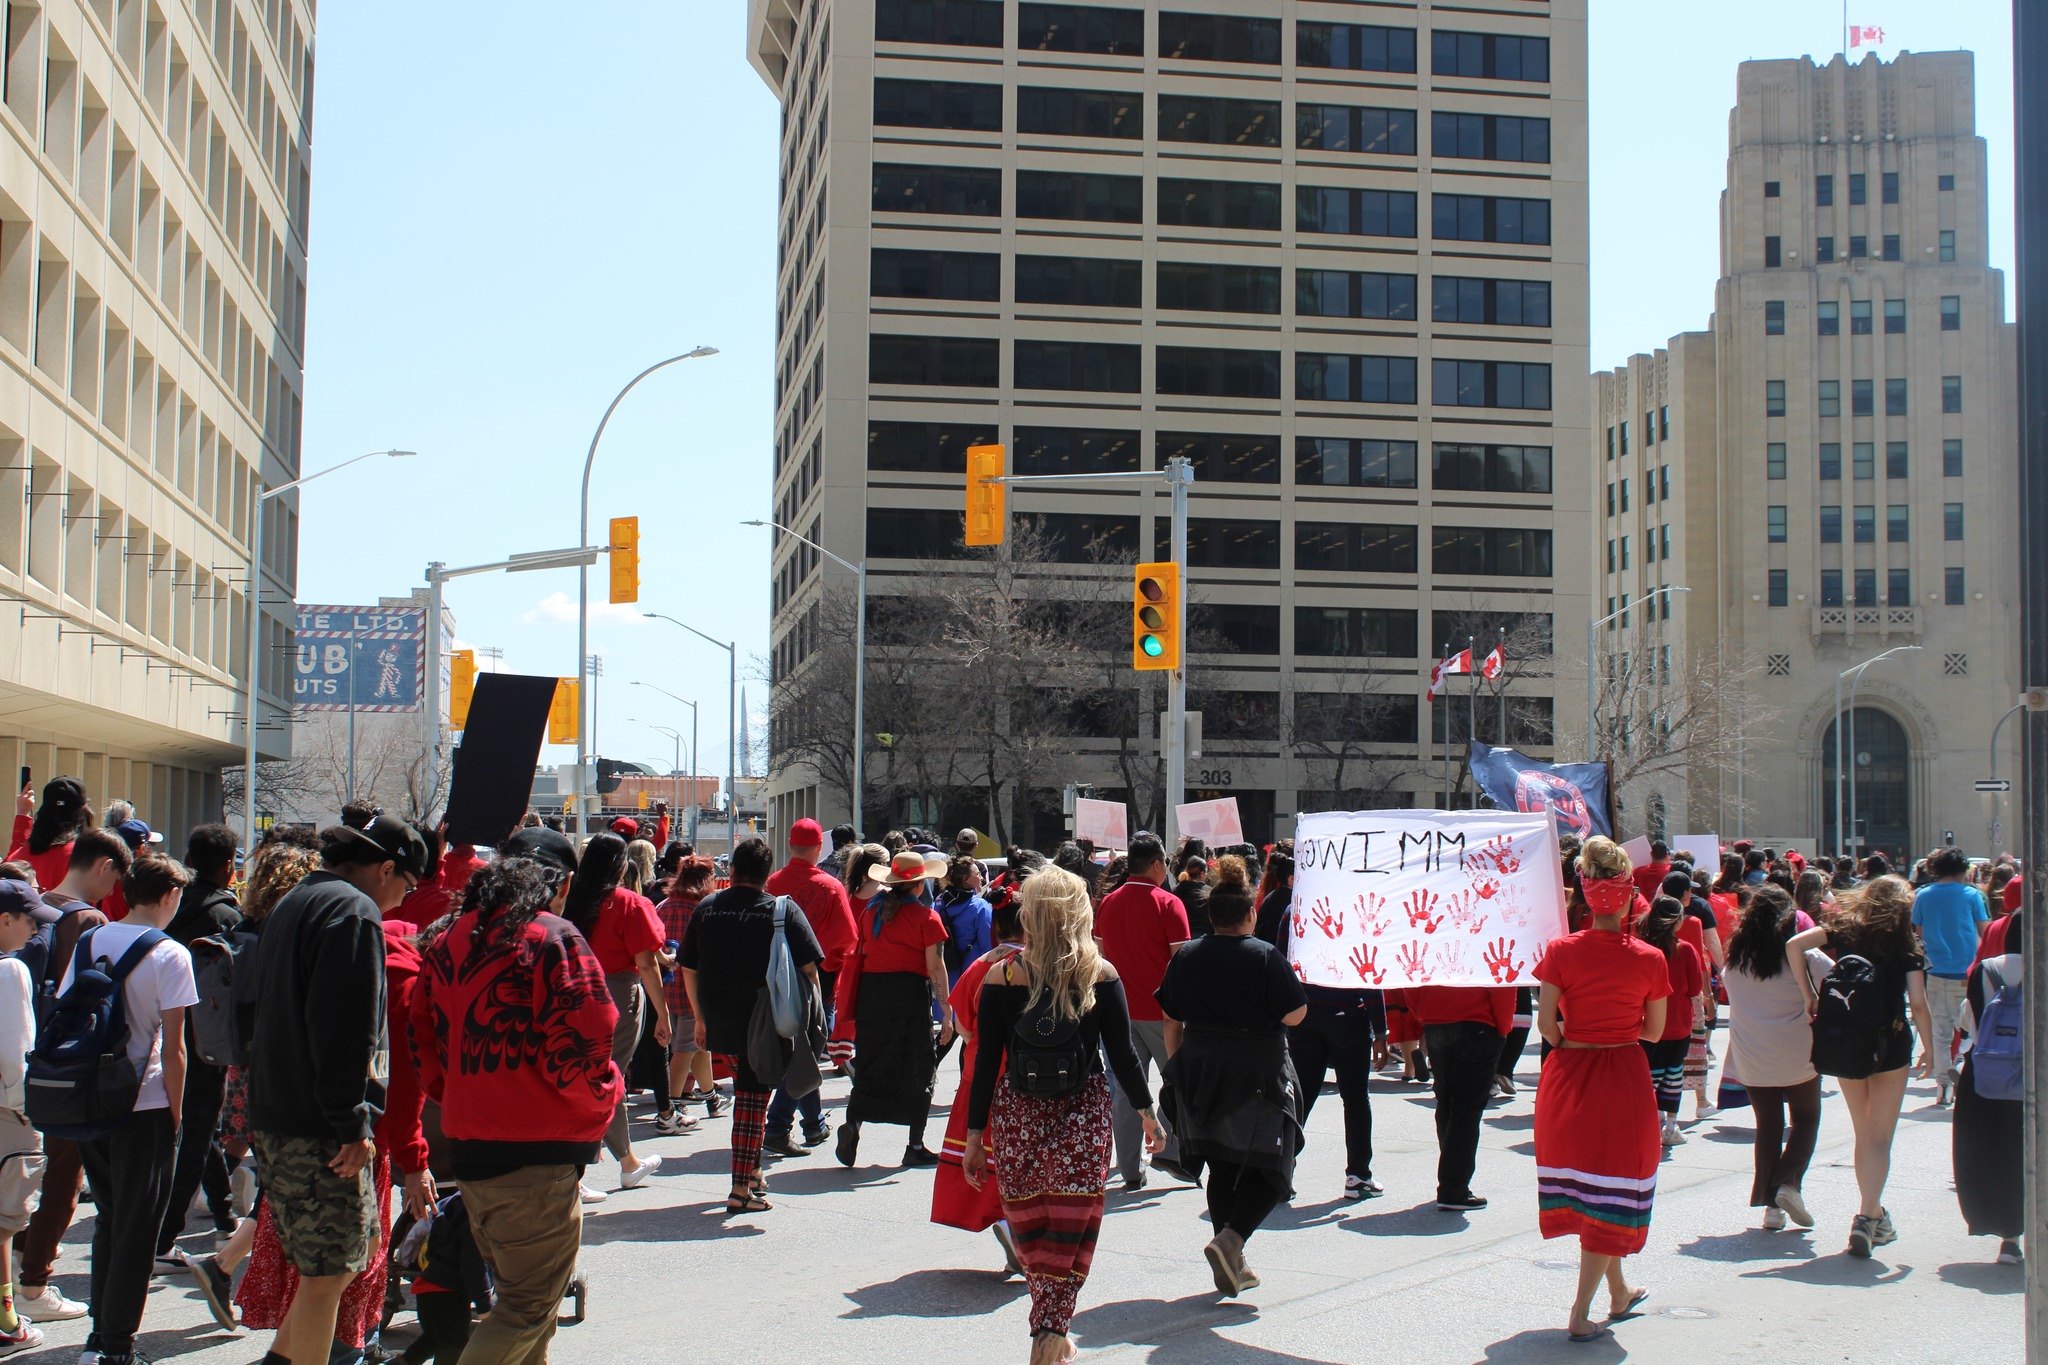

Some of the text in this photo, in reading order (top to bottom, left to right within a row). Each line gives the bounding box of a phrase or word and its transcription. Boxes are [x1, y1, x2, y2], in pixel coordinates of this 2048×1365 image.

[295, 613, 409, 631] TE LTD.
[294, 679, 338, 695] UTS
[1200, 770, 1232, 786] 303
